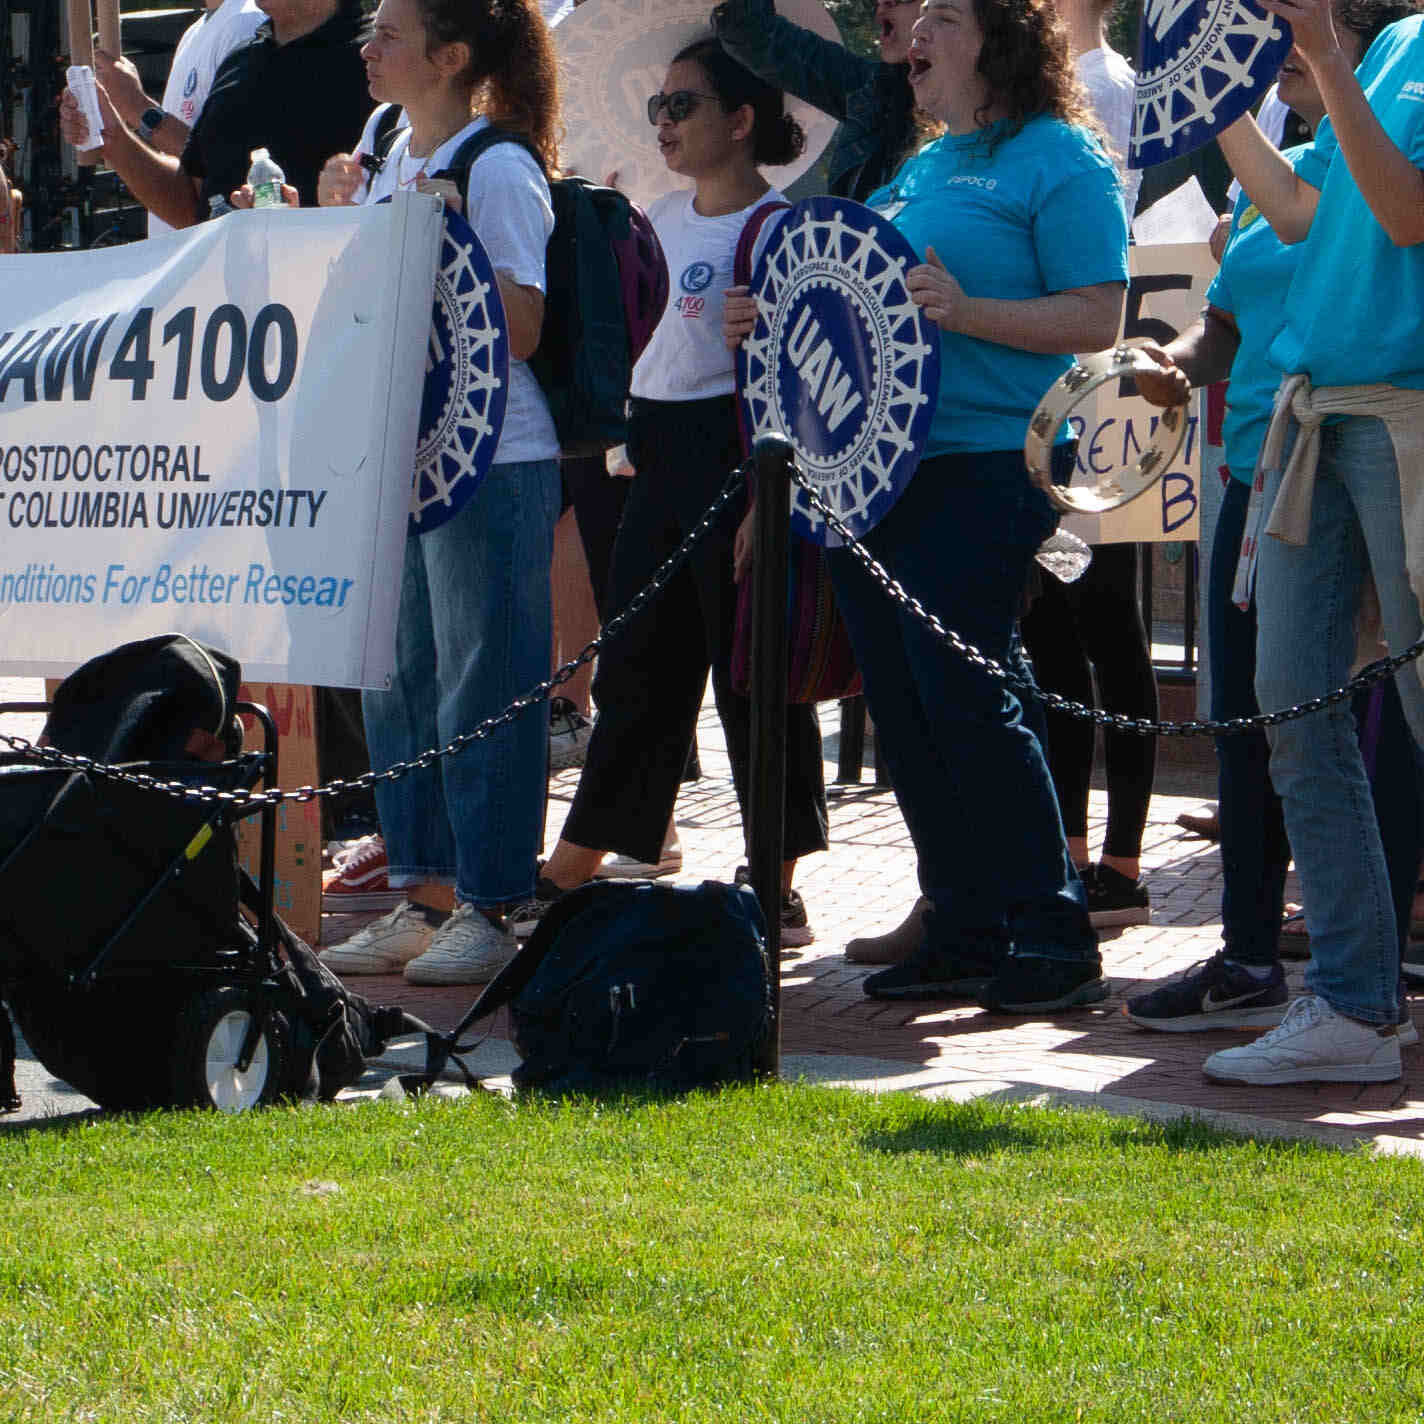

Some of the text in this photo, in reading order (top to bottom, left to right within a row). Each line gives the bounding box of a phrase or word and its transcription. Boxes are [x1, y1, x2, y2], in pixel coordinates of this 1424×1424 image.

[1183, 22, 1225, 75] WORKERS
[109, 303, 299, 403] 4100
[787, 303, 864, 434] UAW
[851, 276, 892, 351] AGRICULTURAL
[875, 353, 892, 424] IMPLEMENT
[8, 491, 149, 529] COLUMBIA
[157, 488, 329, 530] UNIVERSITY
[103, 563, 151, 604] For
[151, 563, 240, 604] Better
[244, 562, 355, 607] Resear
